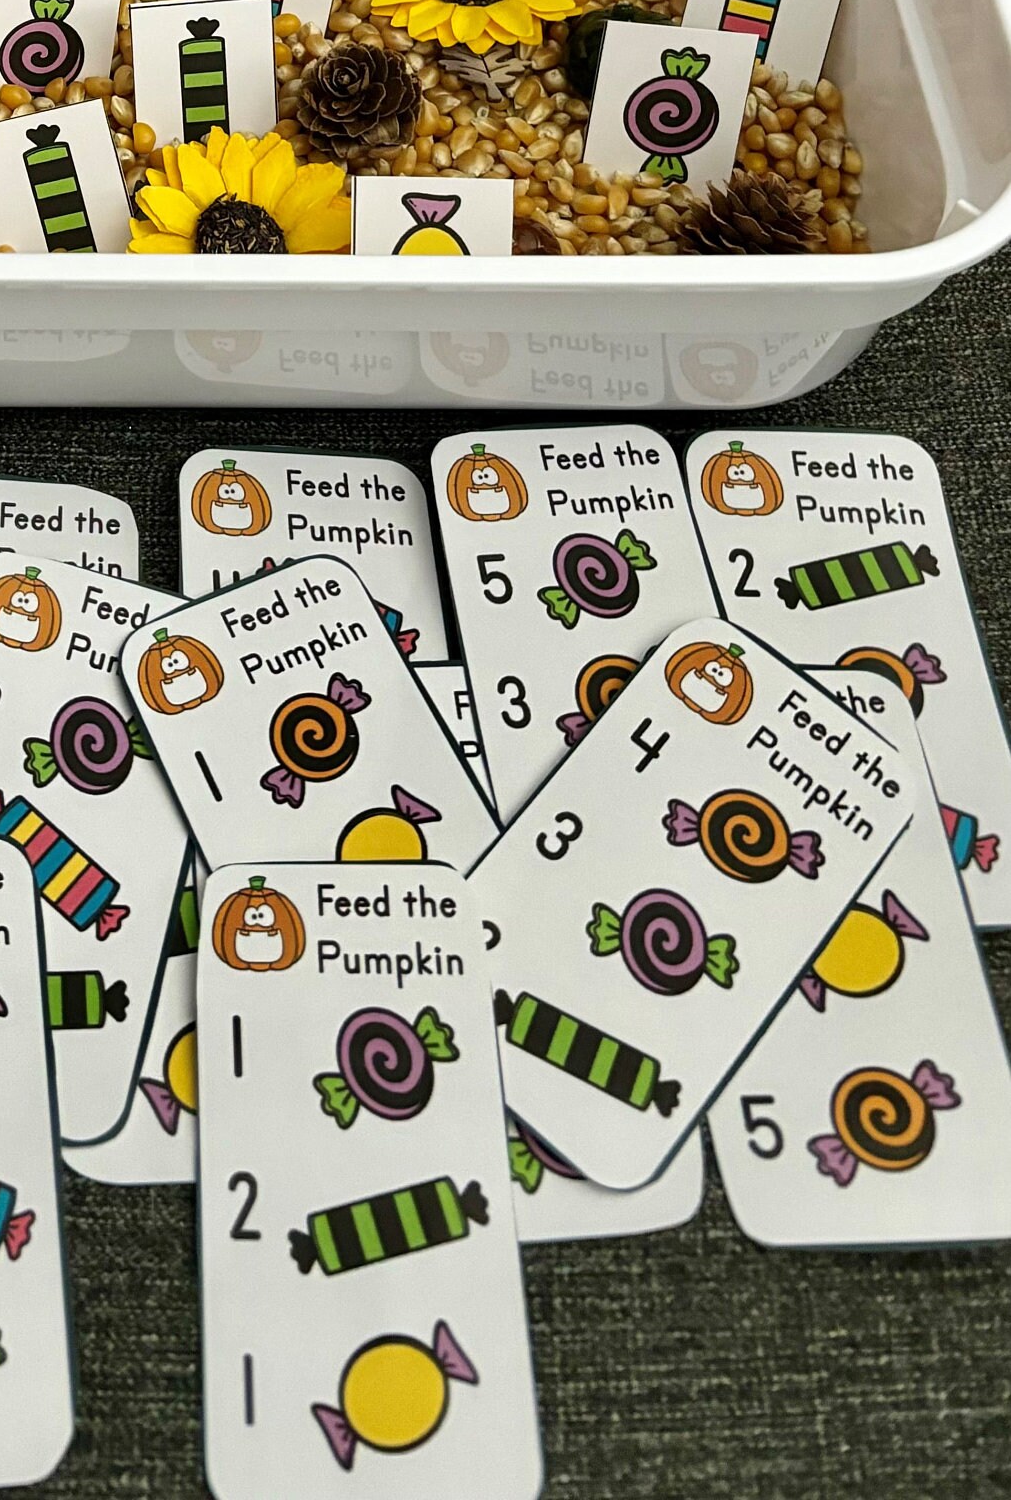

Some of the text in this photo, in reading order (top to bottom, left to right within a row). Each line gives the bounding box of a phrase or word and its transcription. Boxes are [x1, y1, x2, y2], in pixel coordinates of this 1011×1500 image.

[539, 440, 661, 472] Feed the
[791, 450, 914, 481] Feed the
[286, 469, 406, 502] Feed the
[546, 484, 674, 524] Pumpkin
[0, 501, 121, 535] Feed the
[287, 513, 414, 555] Pumpkin
[795, 494, 926, 536] Pumpkin
[476, 553, 514, 605] 5
[728, 548, 761, 598] 2
[81, 586, 150, 629] Feed
[220, 577, 342, 639] Feed the
[239, 613, 368, 685] Pumpkin
[496, 675, 532, 730] 3
[630, 717, 671, 774] 4
[777, 689, 901, 799] Feed the
[194, 750, 223, 803] 1
[746, 725, 874, 842] Pumpkin
[535, 811, 584, 861] 3
[317, 883, 457, 919] Feed the
[317, 939, 464, 990] Pumpkin
[232, 1014, 243, 1078] 1
[739, 1094, 785, 1160] 5
[227, 1171, 262, 1242] 2
[243, 1353, 255, 1427] 1
